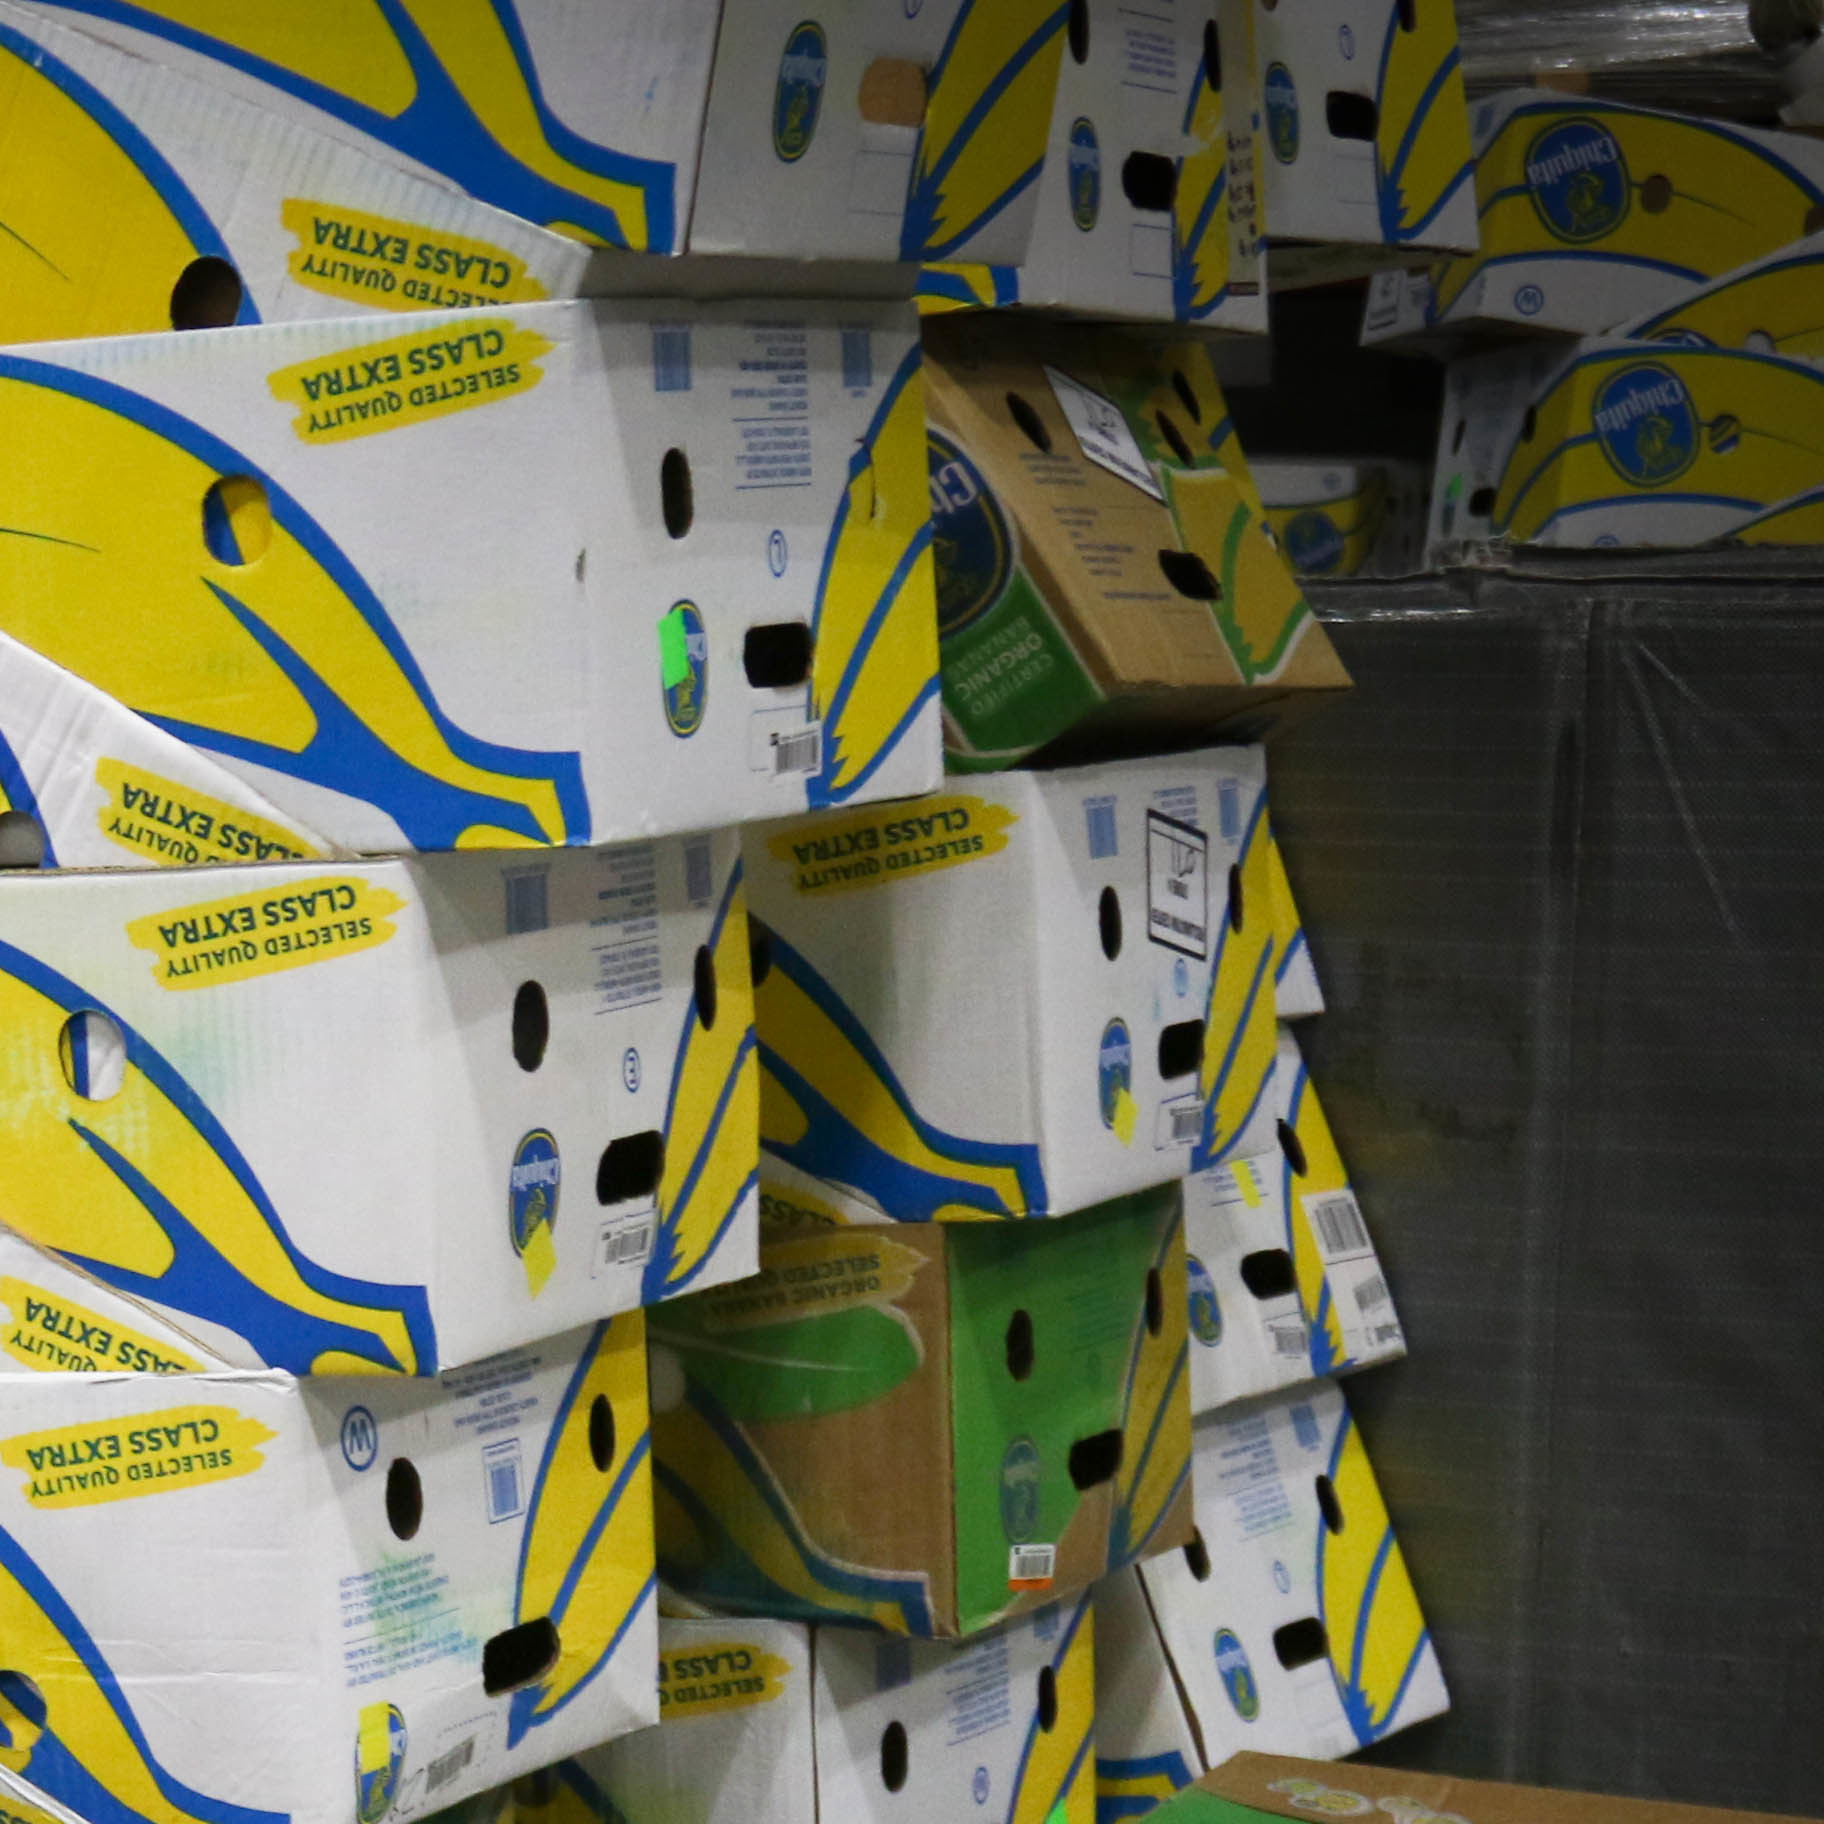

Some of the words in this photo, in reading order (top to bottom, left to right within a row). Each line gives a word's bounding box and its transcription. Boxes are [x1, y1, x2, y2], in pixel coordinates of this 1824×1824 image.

[312, 216, 408, 265] EXTRA
[302, 254, 397, 293] QUALITY
[413, 241, 512, 289] CLASS
[408, 329, 505, 373] CLASS
[301, 354, 403, 400] EXTRA
[409, 364, 521, 406] SELECTED
[307, 391, 402, 432] QUALITY
[122, 783, 214, 841] EXTRA
[886, 808, 969, 844] CLASS
[792, 826, 882, 861] EXTRA
[886, 834, 983, 870] SELECTED
[799, 852, 882, 890] QUALITY
[261, 885, 358, 929] CLASS
[159, 905, 256, 949] EXTRA
[264, 917, 372, 956] SELECTED
[166, 939, 259, 978] QUALITY
[24, 1296, 113, 1357] EXTRA
[26, 1434, 123, 1471] EXTRA
[129, 1418, 219, 1455] CLASS
[30, 1466, 121, 1499] QUALITY
[127, 1448, 232, 1481] SELECTED
[674, 1650, 751, 1680] CLASS
[674, 1677, 764, 1703] SELECTED
